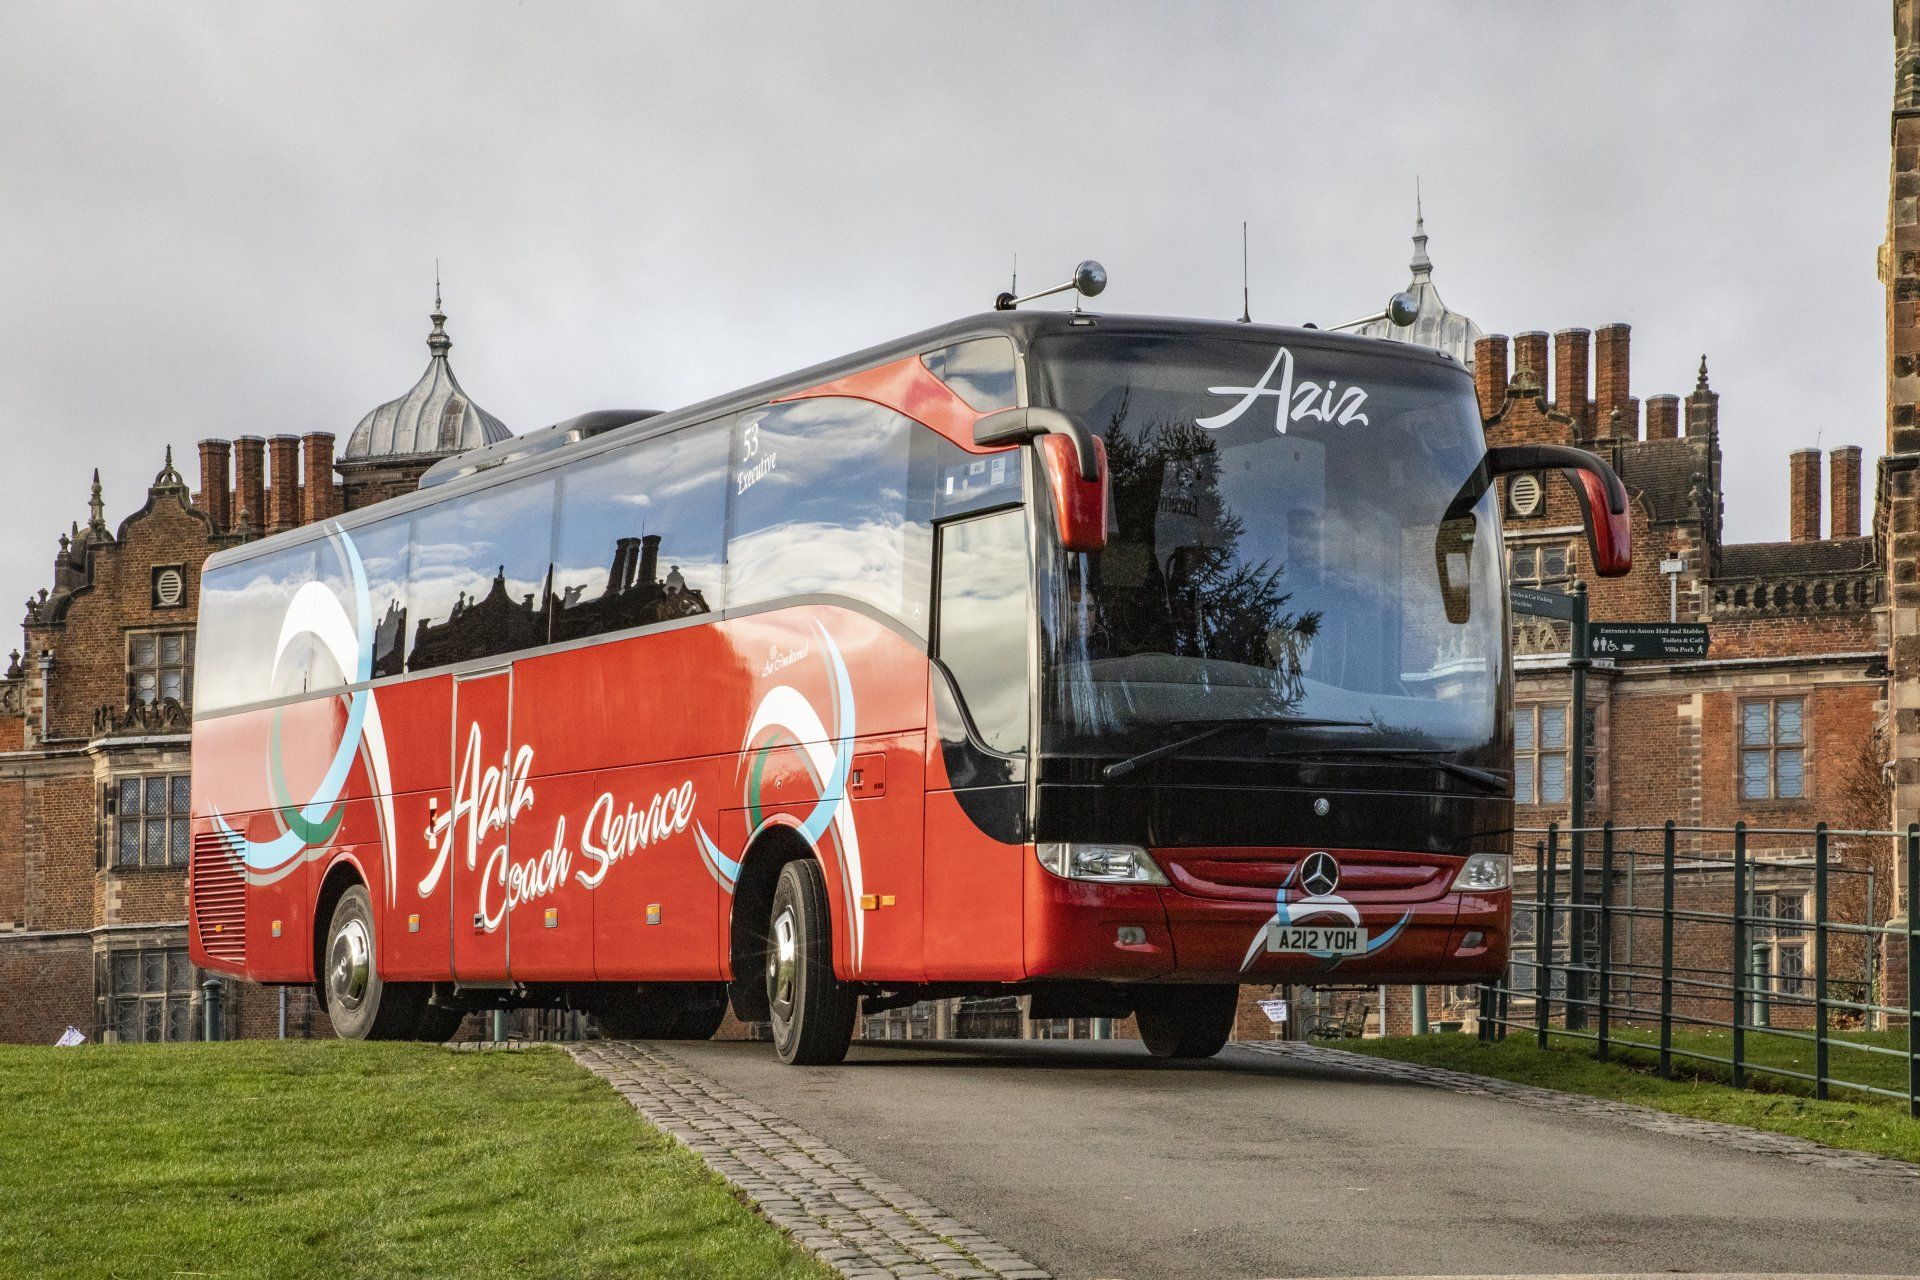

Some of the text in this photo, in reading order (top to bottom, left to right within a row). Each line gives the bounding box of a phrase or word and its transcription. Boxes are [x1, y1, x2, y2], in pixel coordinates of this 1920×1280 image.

[1195, 346, 1369, 435] Aziz
[736, 451, 777, 496] Executive
[743, 423, 759, 463] 53
[418, 720, 534, 896] Aziz
[479, 780, 697, 932] Coach Service
[1278, 930, 1357, 950] A212 YOH
